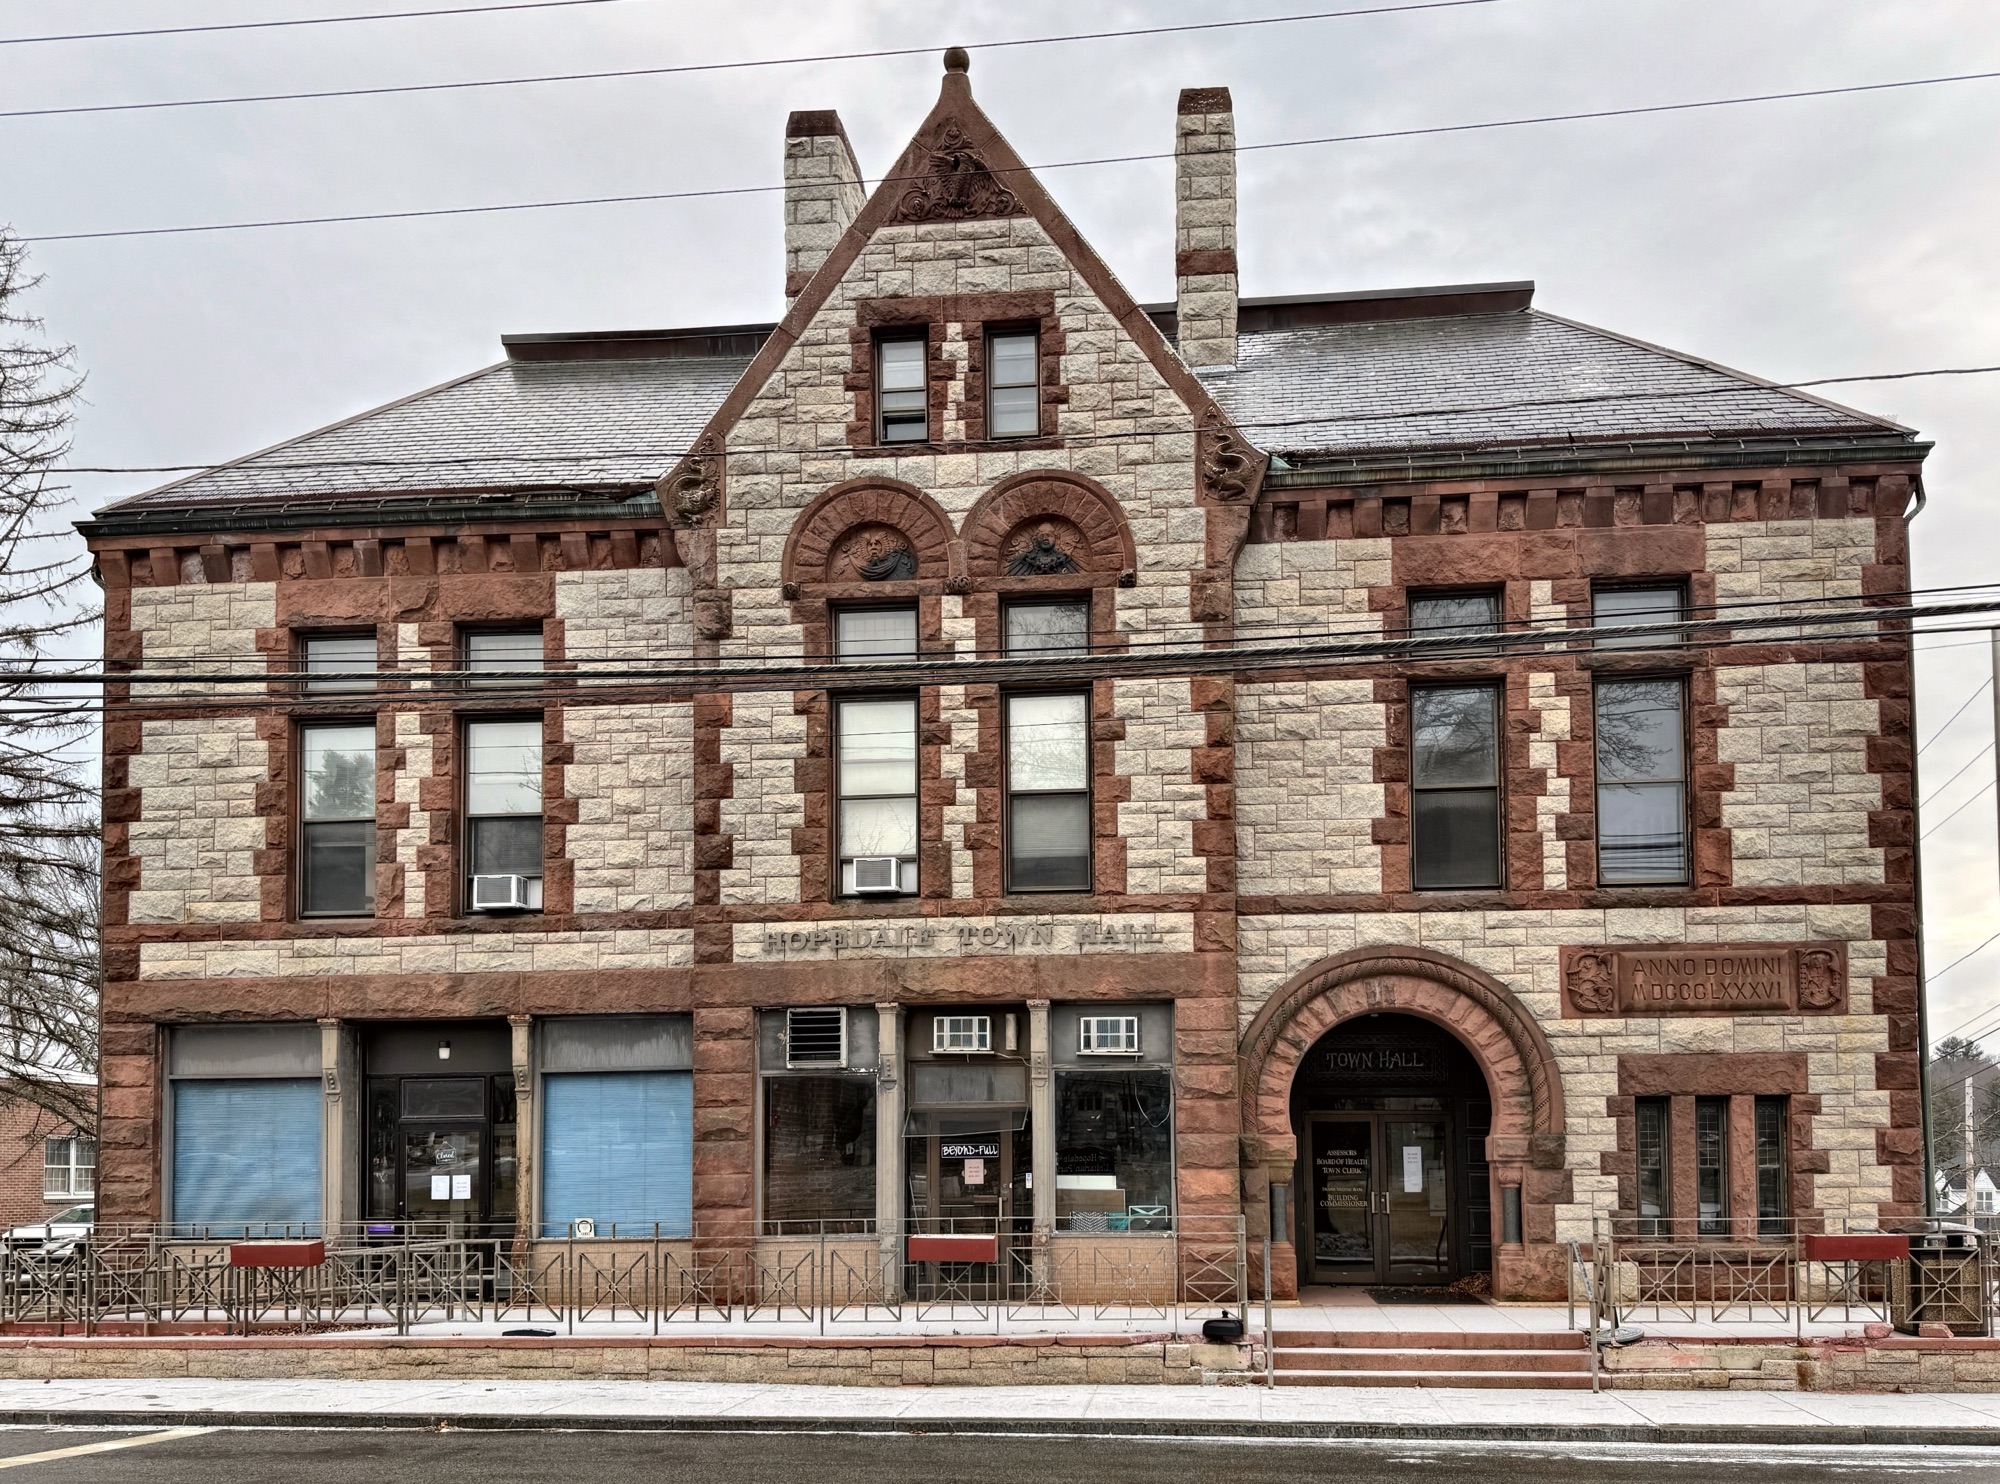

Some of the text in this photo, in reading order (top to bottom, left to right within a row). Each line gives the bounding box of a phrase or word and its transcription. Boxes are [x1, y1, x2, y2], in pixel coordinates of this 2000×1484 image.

[762, 922, 1164, 951] HOPEDALE TOWN HALL
[1632, 958, 1782, 977] ANNO DOMINI
[1632, 982, 1782, 1001] MDCCCLXXXVI
[1326, 1049, 1424, 1069] TOWN HALL
[437, 1151, 455, 1159] Closed
